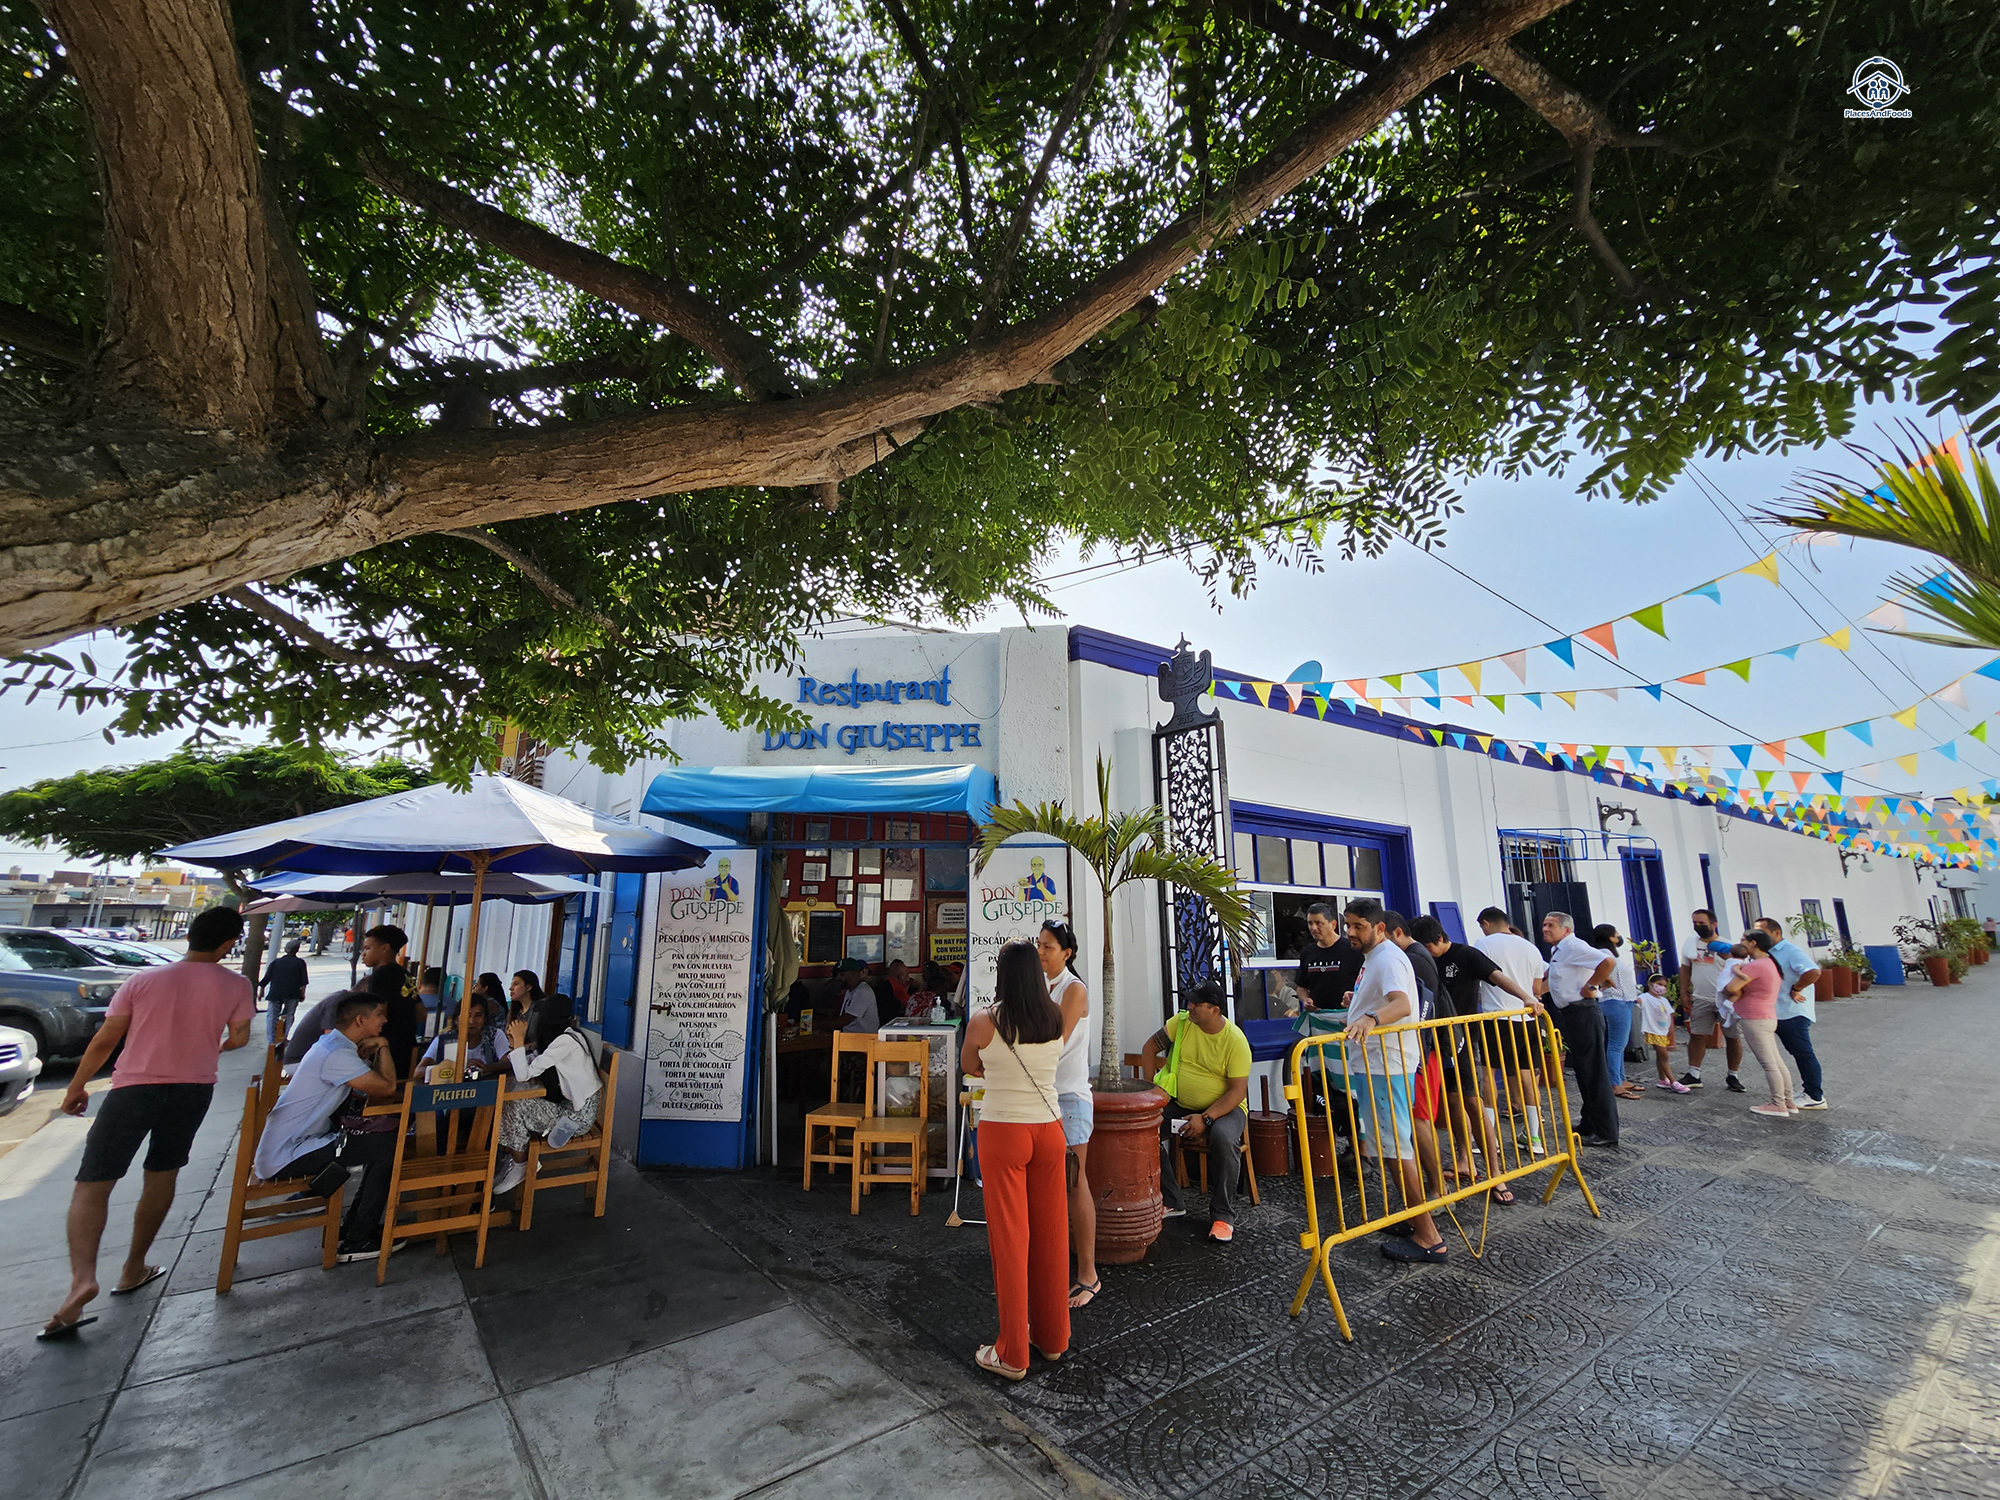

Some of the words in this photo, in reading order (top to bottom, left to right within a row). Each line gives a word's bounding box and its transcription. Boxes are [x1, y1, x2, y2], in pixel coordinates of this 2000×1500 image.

[797, 664, 952, 709] Restaurant
[763, 722, 830, 751] DON
[836, 720, 982, 755] GIUSEPPE
[670, 886, 702, 902] DON
[981, 885, 1015, 902] DON
[670, 898, 744, 924] GIUSEPPE
[982, 899, 1063, 923] GIUSEPPE
[658, 935, 700, 943] PESCADOS
[709, 935, 750, 943] MARISCOS
[972, 937, 1011, 945] PESCAD
[659, 1061, 680, 1069] TORTA
[682, 1061, 690, 1069] DE
[692, 1061, 732, 1069] CHOCOLATE
[432, 1088, 476, 1105] PACIFICO
[662, 1102, 688, 1110] DULCES
[690, 1102, 724, 1110] CRIOLLOS
